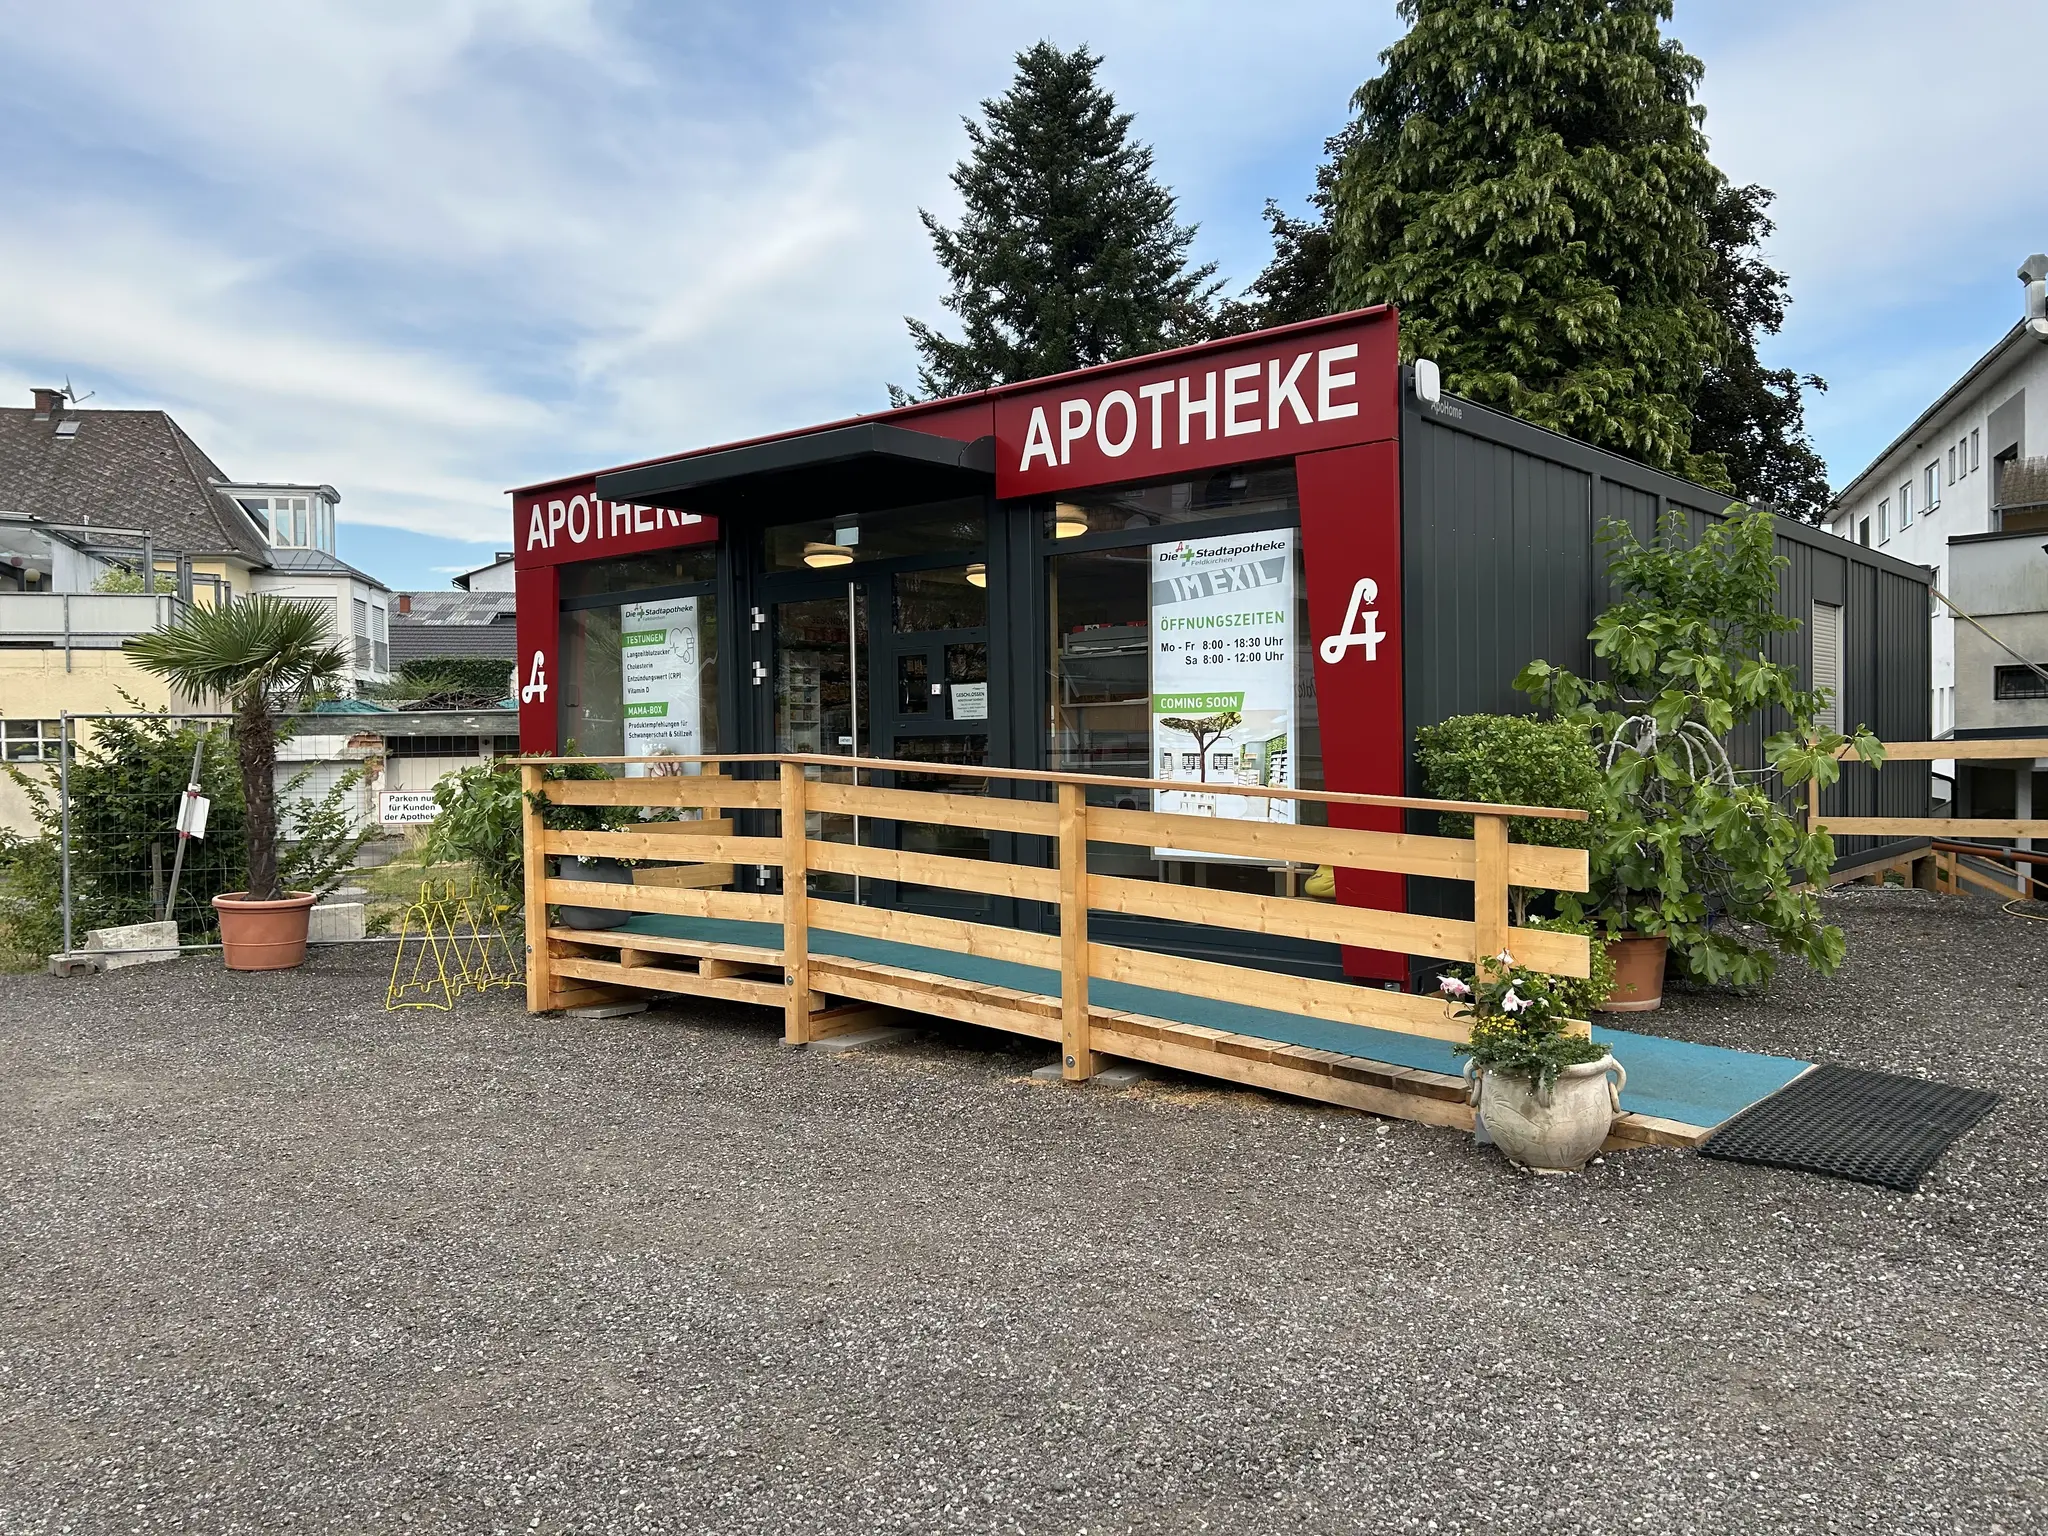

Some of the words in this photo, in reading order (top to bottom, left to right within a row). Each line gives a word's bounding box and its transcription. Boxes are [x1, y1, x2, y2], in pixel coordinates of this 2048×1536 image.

[1019, 343, 1359, 472] APOTHEKE
[1431, 401, 1463, 419] ApoHome
[527, 492, 702, 551] APOTHE
[1160, 552, 1178, 562] Die
[1196, 541, 1286, 558] Stadtapotheke
[1190, 557, 1233, 566] Feldkirchen
[1169, 574, 1205, 602] IM
[1207, 562, 1278, 595] EXIL
[645, 605, 694, 615] Stadtapotheke
[1160, 611, 1285, 631] ÖFFNUNGSZEITEN
[626, 633, 664, 644] TESTUNGEN
[1161, 643, 1175, 652] Mo
[1185, 642, 1195, 651] Fr
[1202, 640, 1223, 650] 8:00
[1234, 637, 1261, 648] 18:30
[1264, 636, 1284, 647] Uhr
[627, 649, 670, 658] Langzeitblutzucker
[1185, 656, 1198, 665] Sa
[1203, 654, 1224, 664] 8:00
[1234, 652, 1261, 663] 12:00
[1265, 651, 1285, 661] Uhr
[627, 662, 653, 670] Cholesterin
[627, 673, 668, 682] Entzündungswert
[668, 672, 682, 680] (CRP)
[1160, 698, 1203, 709] COMING
[1206, 696, 1238, 708] SOON
[628, 706, 663, 715] MAMA-BOX
[628, 721, 680, 729] Produktempfehlungen
[628, 731, 668, 739] Schwangerschaft
[384, 813, 399, 821] der
[400, 813, 435, 821] Apothek
